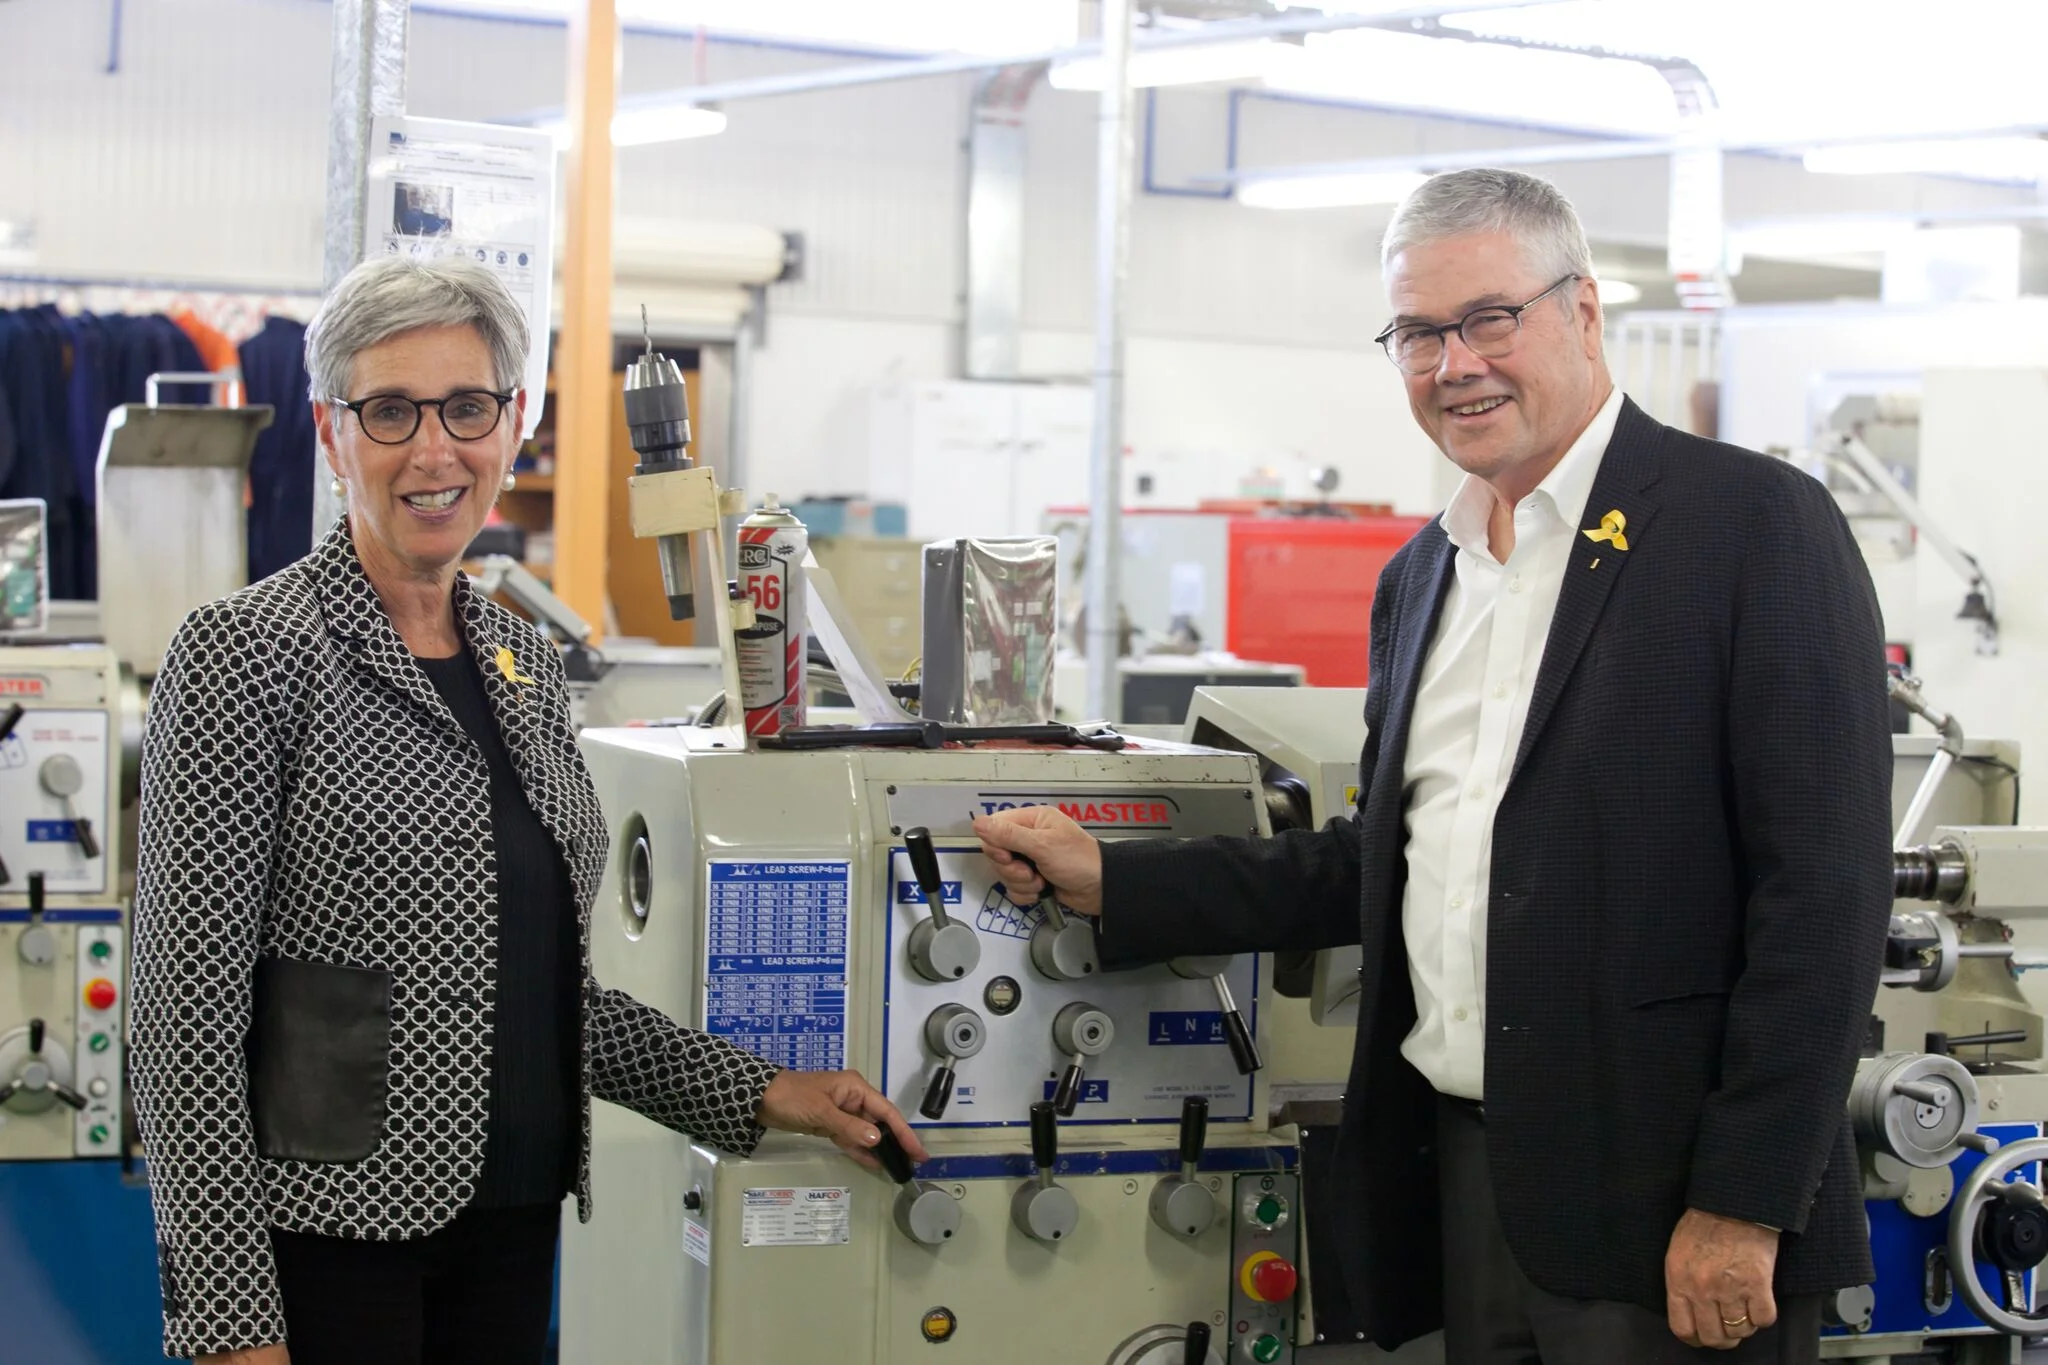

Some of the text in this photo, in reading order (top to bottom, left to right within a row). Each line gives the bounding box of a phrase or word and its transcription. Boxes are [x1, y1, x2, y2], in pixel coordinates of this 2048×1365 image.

[764, 865, 786, 874] LEAD
[909, 884, 920, 897] X
[944, 884, 955, 897] Y
[985, 905, 995, 915] X
[997, 911, 1007, 920] Y
[1009, 917, 1019, 926] X
[1021, 923, 1031, 932] Y
[762, 957, 784, 966] LEAD
[1160, 1023, 1169, 1035] L
[1185, 1018, 1197, 1032] N
[1211, 1022, 1222, 1034] H
